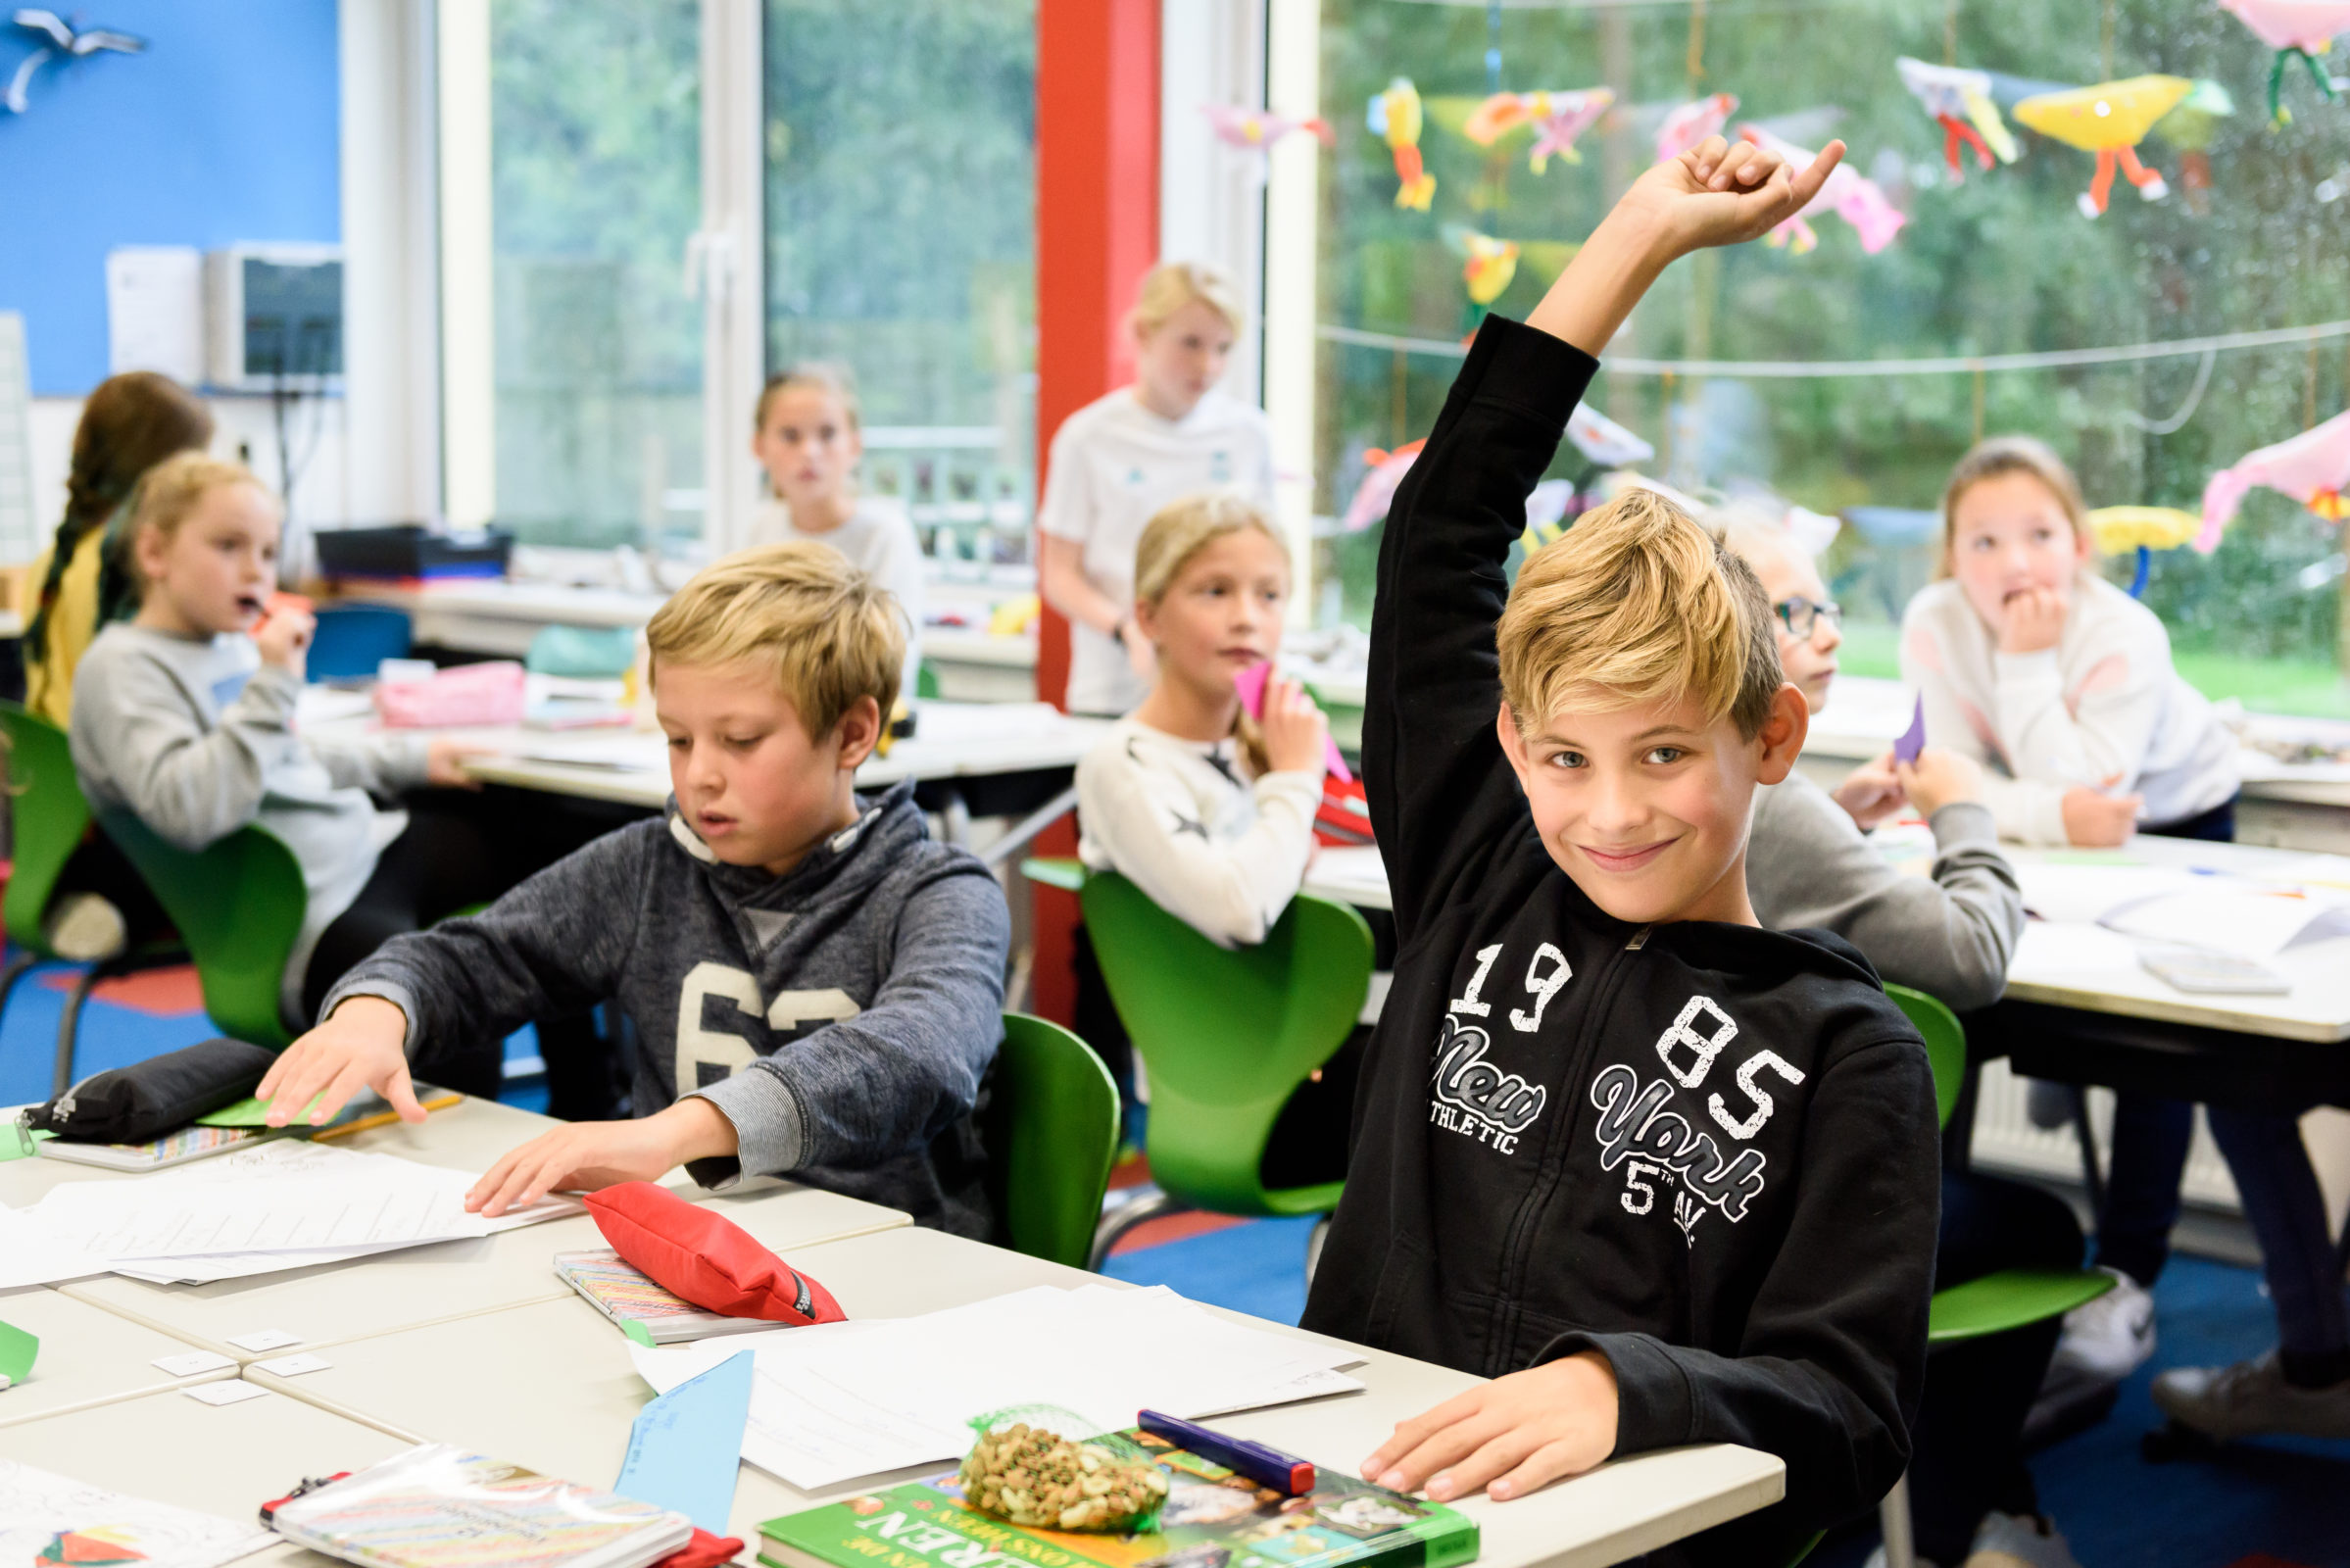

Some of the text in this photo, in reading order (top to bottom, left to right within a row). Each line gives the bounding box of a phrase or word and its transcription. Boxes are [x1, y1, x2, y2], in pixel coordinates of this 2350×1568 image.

[1429, 1013, 1766, 1223] New York
[1430, 1100, 1519, 1155] THLETIC
[1449, 942, 1806, 1140] 19 85
